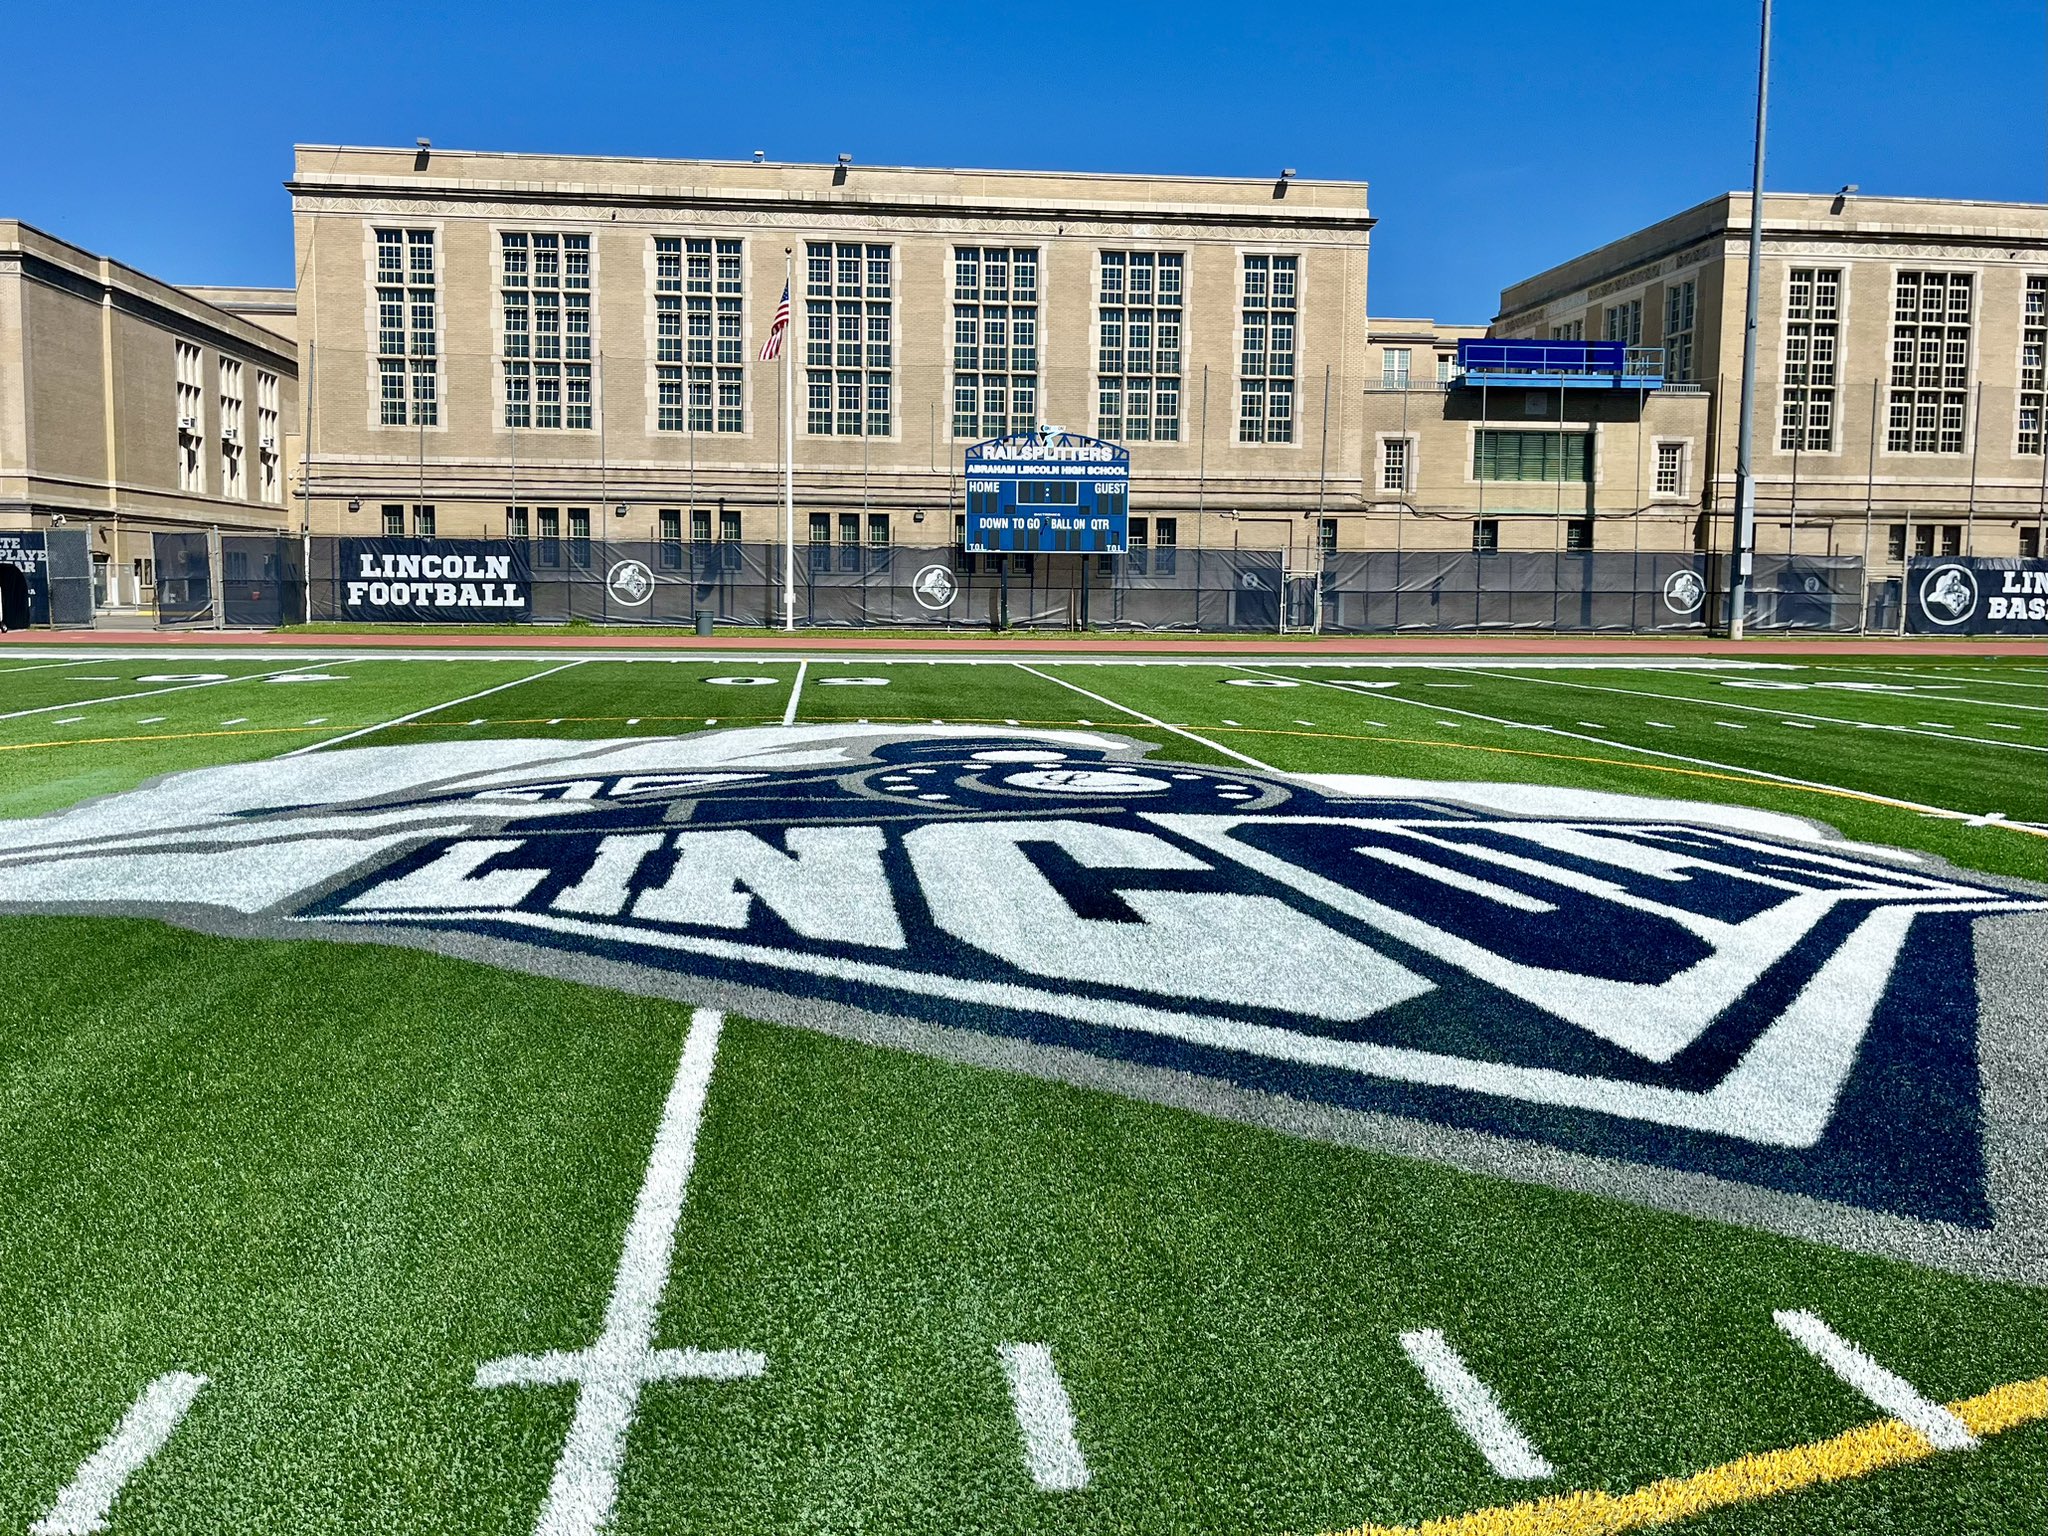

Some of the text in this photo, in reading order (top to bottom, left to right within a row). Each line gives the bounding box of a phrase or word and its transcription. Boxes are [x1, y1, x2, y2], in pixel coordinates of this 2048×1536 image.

[982, 445, 1113, 461] RAILSPLITTERS
[967, 465, 1127, 476] ABRAHAM LINCOLN HIGH SCHOOL
[969, 481, 1000, 493] HOME
[1094, 483, 1126, 494] GUEST
[979, 517, 1009, 529] DOWN
[1012, 518, 1041, 529] TO GO
[1051, 518, 1086, 530] BALL ON
[1090, 518, 1110, 530] QTR
[360, 553, 511, 579] LINCOLN
[347, 582, 525, 607] FOOTBALL
[1987, 596, 2048, 620] BAS
